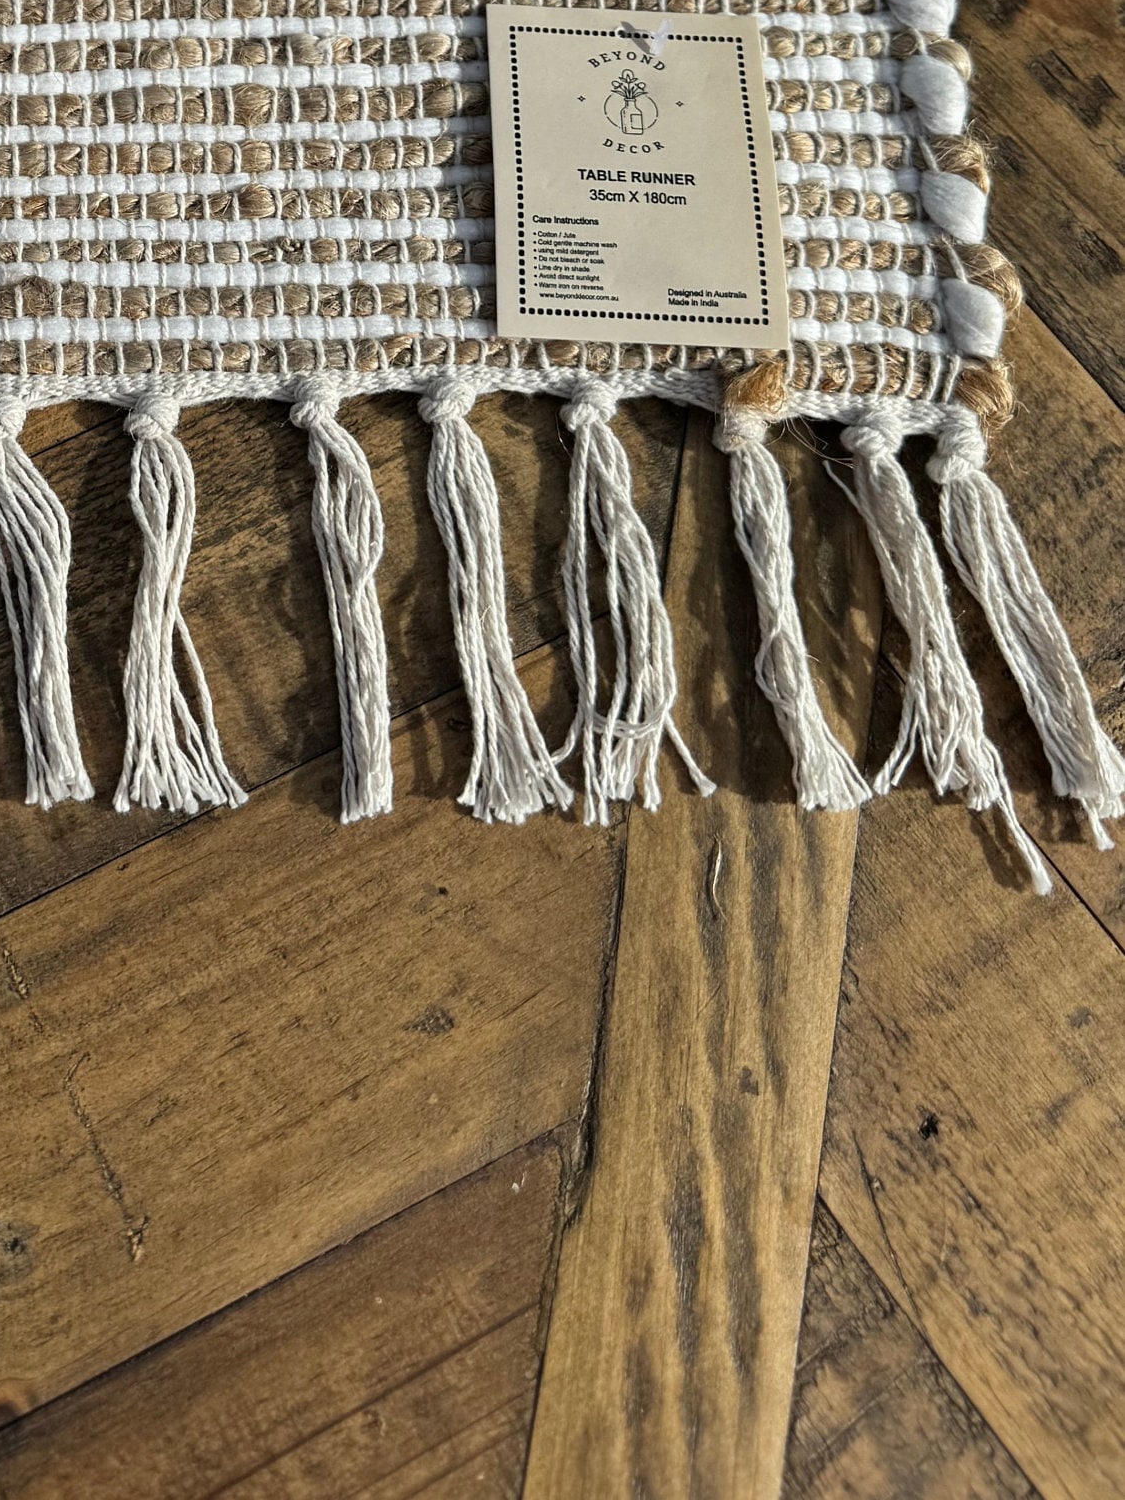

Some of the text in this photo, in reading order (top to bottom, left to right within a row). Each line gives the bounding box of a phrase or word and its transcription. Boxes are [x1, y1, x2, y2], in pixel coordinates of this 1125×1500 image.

[588, 51, 666, 72] BEYOND
[603, 138, 665, 154] DECOR
[577, 168, 696, 186] TABLE RUNNER
[589, 189, 687, 205] 35cm X 180cm
[532, 215, 599, 225] Care Instructions
[538, 239, 552, 247] Cold
[553, 240, 572, 248] gentle
[570, 249, 599, 257] detergent
[560, 256, 580, 264] bleach
[553, 264, 563, 273] dry
[571, 265, 590, 273] shade
[576, 274, 600, 282] sunlight
[668, 289, 704, 298] Designed
[714, 290, 747, 299] Australia
[668, 298, 689, 306] Made
[700, 299, 719, 308] India
